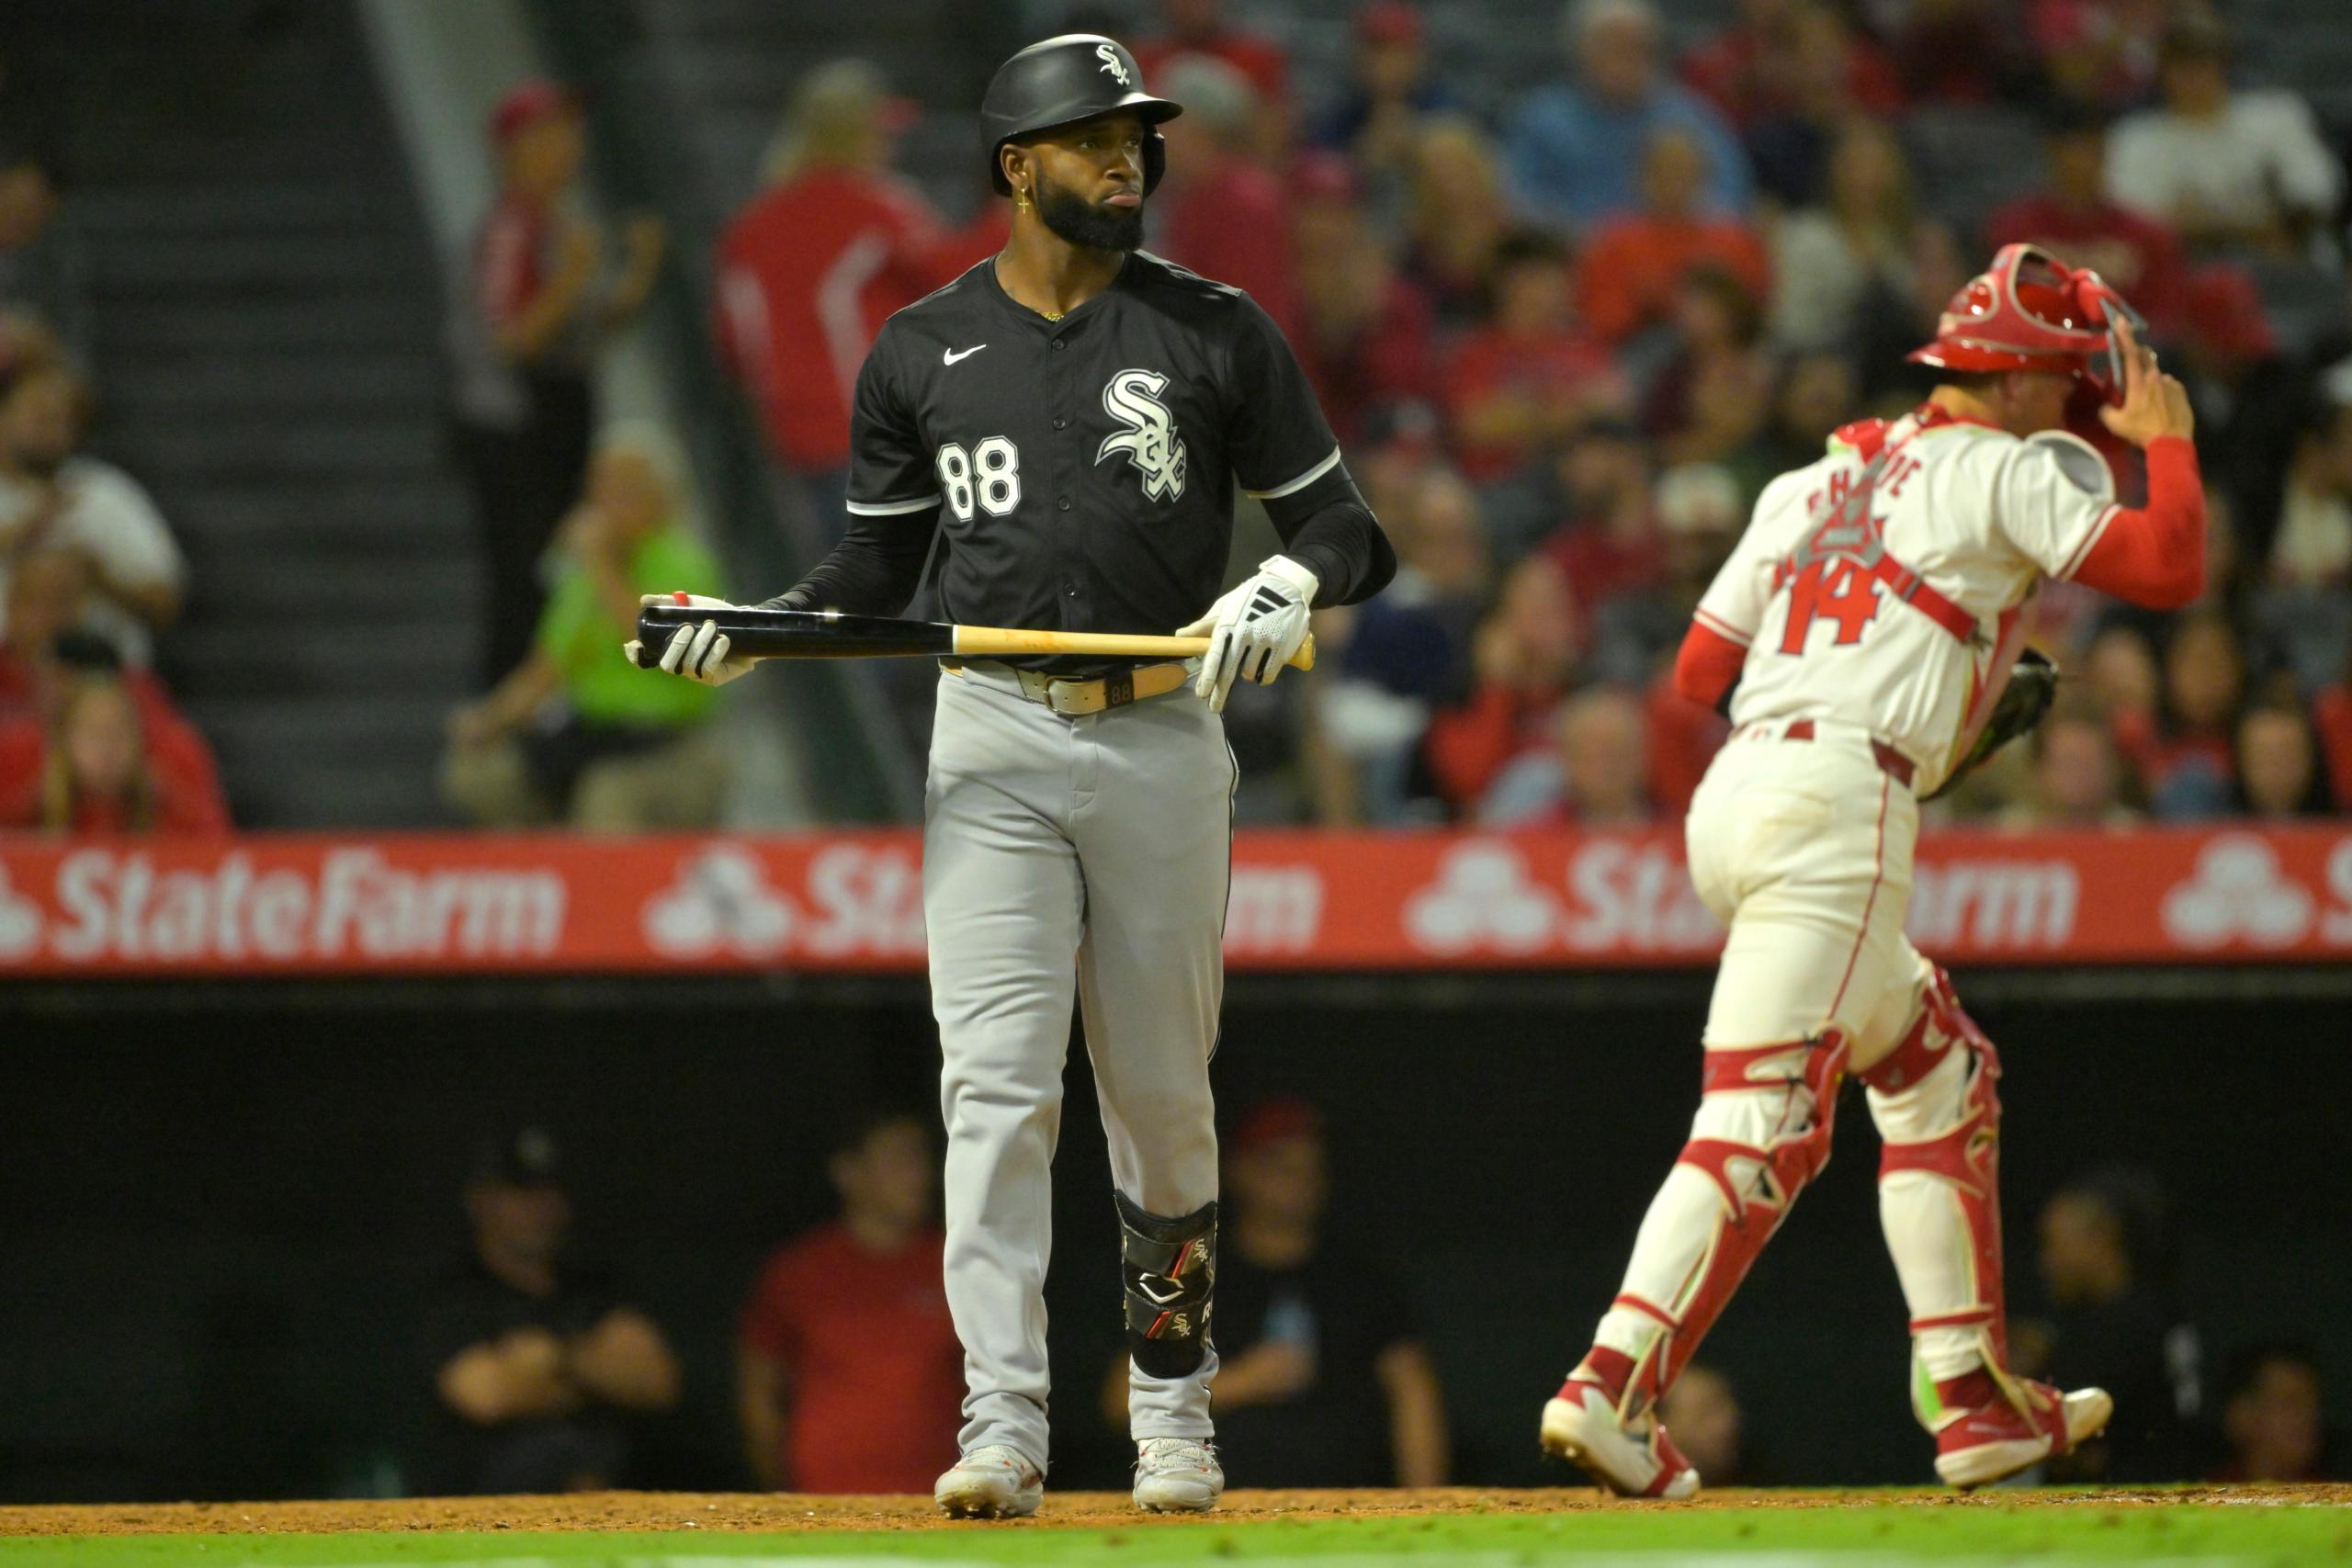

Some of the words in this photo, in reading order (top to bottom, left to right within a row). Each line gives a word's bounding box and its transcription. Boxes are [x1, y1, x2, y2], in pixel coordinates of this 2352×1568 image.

[936, 435, 1021, 522] 88
[1777, 556, 1883, 655] 14
[1112, 683, 1131, 705] 88
